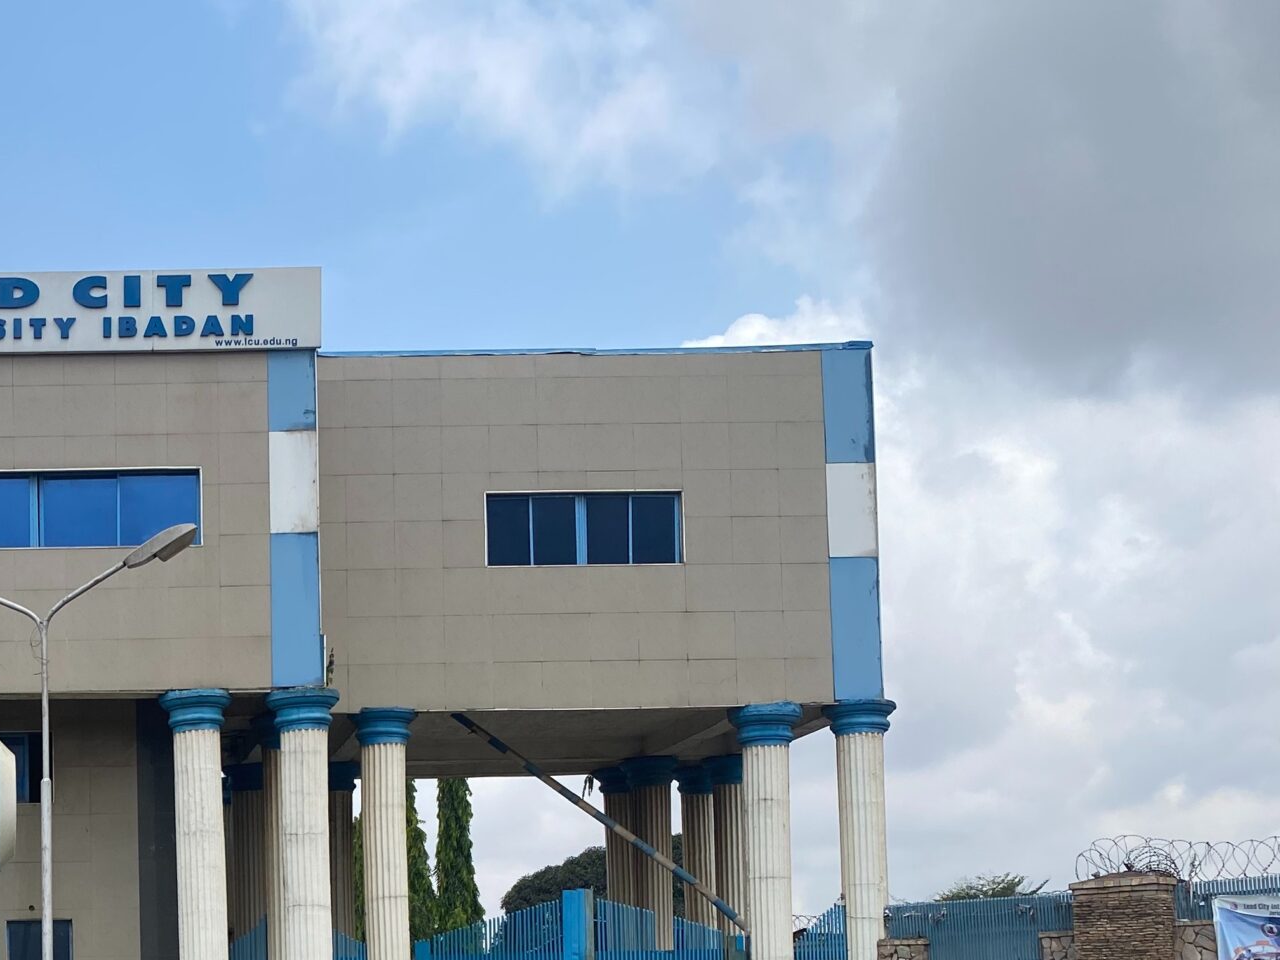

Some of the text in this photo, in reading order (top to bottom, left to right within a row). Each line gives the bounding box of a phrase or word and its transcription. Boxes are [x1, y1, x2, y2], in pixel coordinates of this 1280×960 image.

[72, 273, 254, 309] CITY
[103, 314, 254, 338] IBADAN
[215, 336, 298, 347] www.lcu.edu.ng
